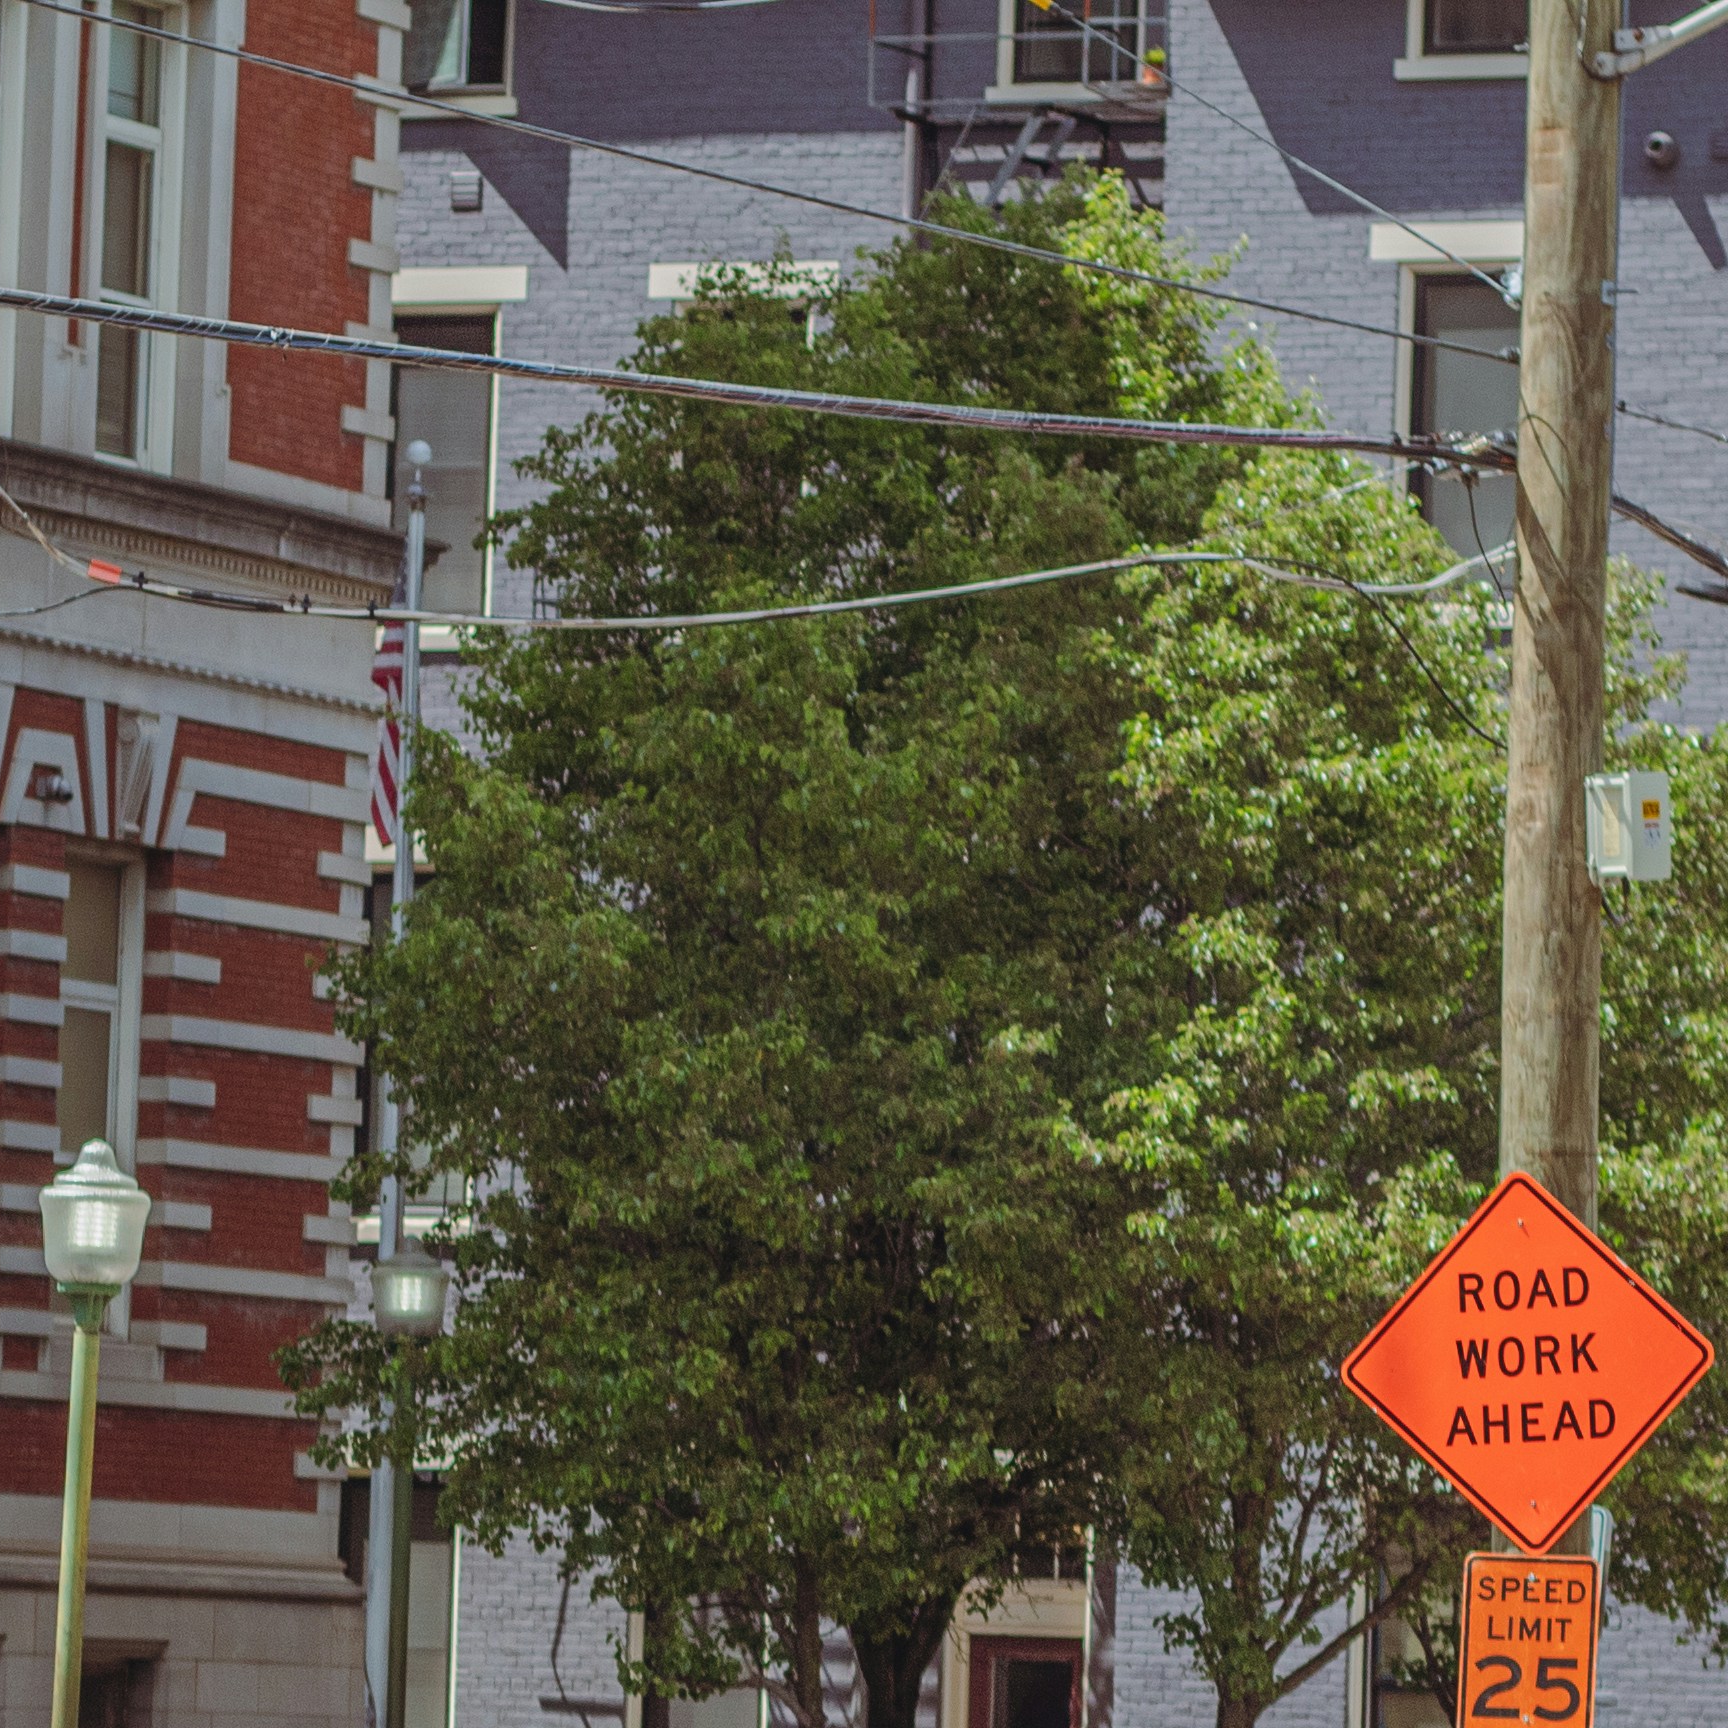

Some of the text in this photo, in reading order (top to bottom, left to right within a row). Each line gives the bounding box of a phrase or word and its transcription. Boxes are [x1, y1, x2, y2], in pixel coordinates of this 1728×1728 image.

[1457, 1265, 1591, 1313] ROAD
[1455, 1331, 1599, 1380] WORK
[1445, 1398, 1617, 1447] AHEAD
[1477, 1576, 1587, 1605] SPEED
[1487, 1616, 1573, 1644] LIMIT
[1472, 1654, 1581, 1721] 25
